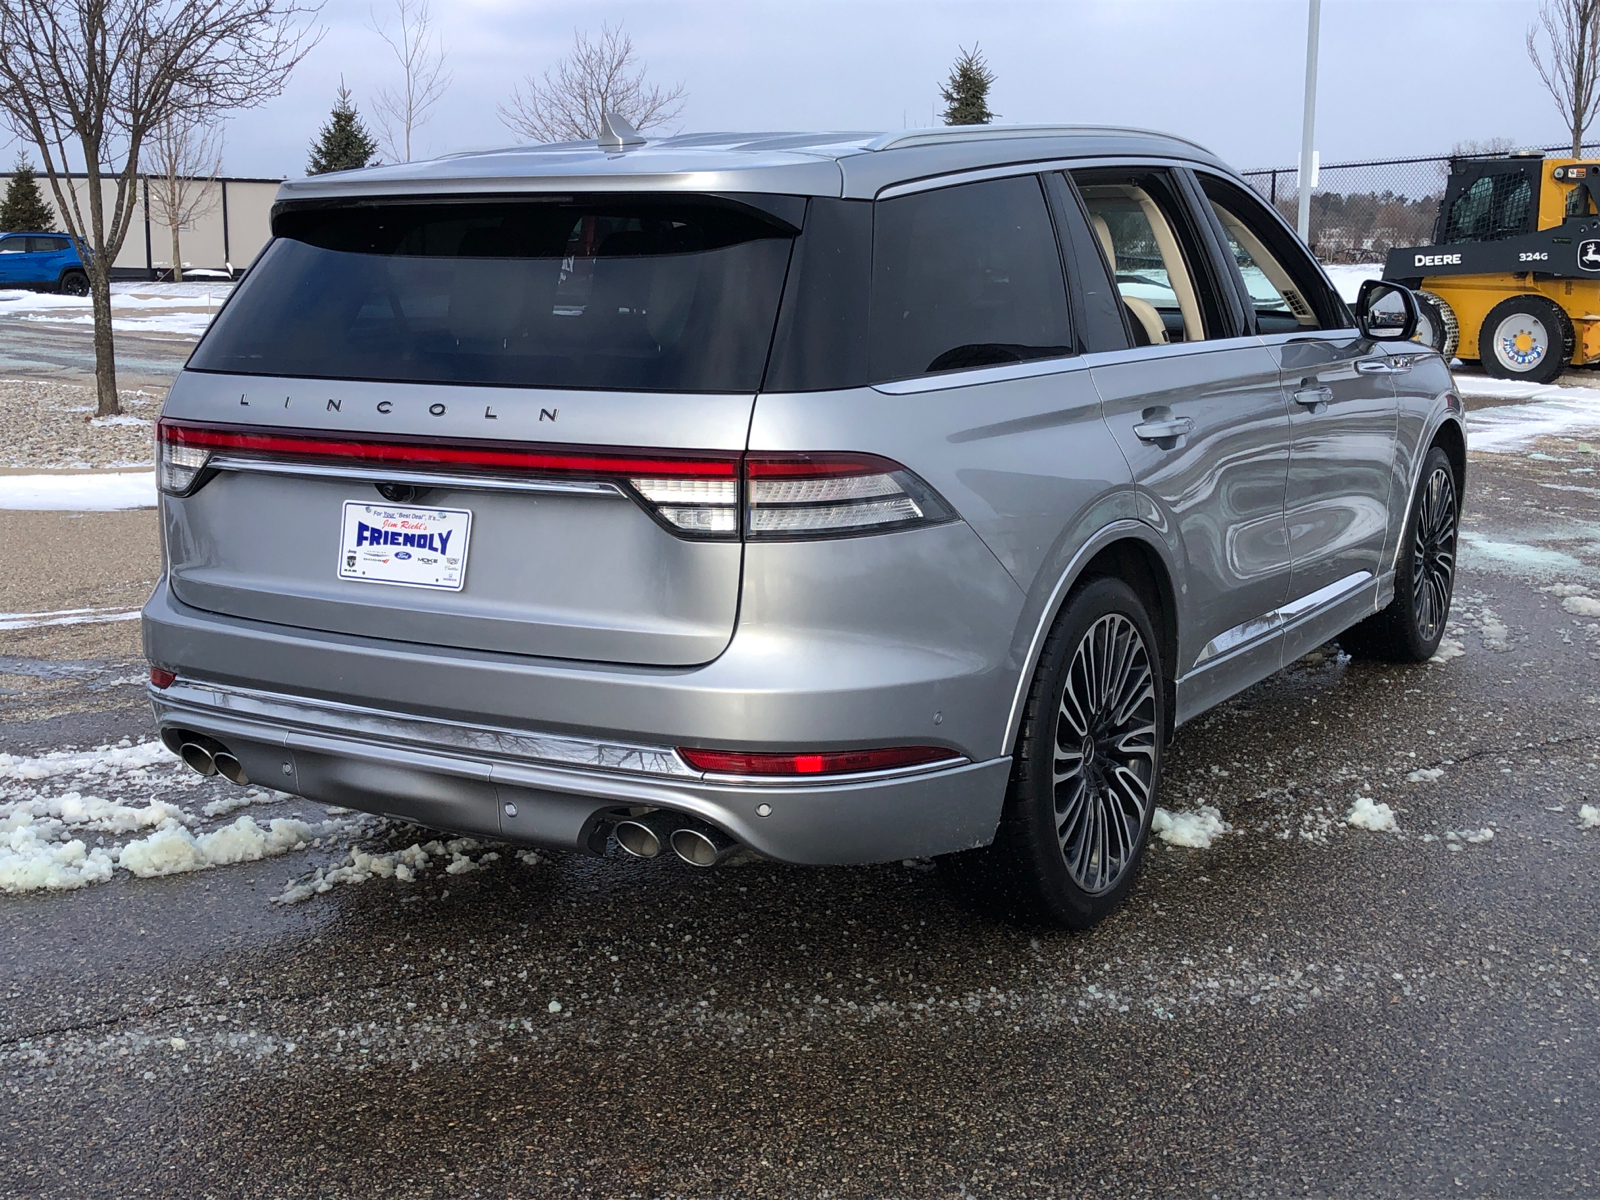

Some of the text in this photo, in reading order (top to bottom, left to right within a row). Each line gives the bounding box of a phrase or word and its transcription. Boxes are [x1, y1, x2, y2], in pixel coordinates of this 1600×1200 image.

[1414, 254, 1461, 267] DEERE
[1519, 252, 1548, 262] 324G
[240, 393, 559, 422] LINCOLN
[383, 511, 396, 519] Your
[381, 519, 427, 530] Jim Riehl's
[356, 520, 453, 556] FRIENDLY
